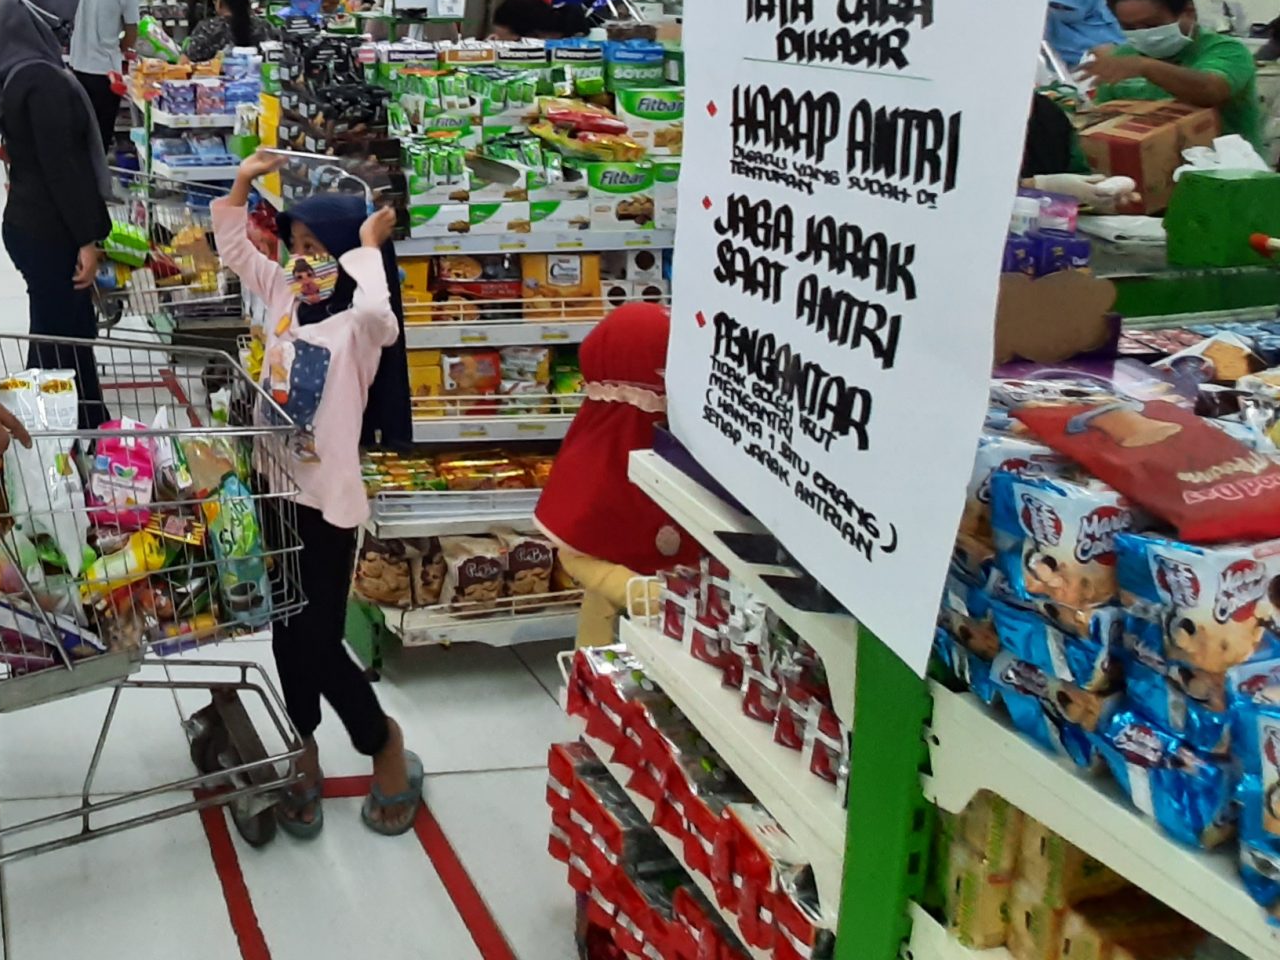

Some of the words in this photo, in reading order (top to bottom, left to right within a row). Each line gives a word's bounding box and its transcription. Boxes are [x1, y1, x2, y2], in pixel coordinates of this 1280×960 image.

[600, 168, 647, 186] Fitbar
[730, 83, 841, 165] HARAP
[846, 97, 962, 194] ANTRI
[714, 192, 795, 255] JAGA
[795, 214, 917, 301] JARAK
[713, 238, 789, 305] SAAT
[796, 273, 902, 370] ANTRI
[708, 372, 794, 445] MENGANTRI
[713, 311, 873, 452] PENGANTAR
